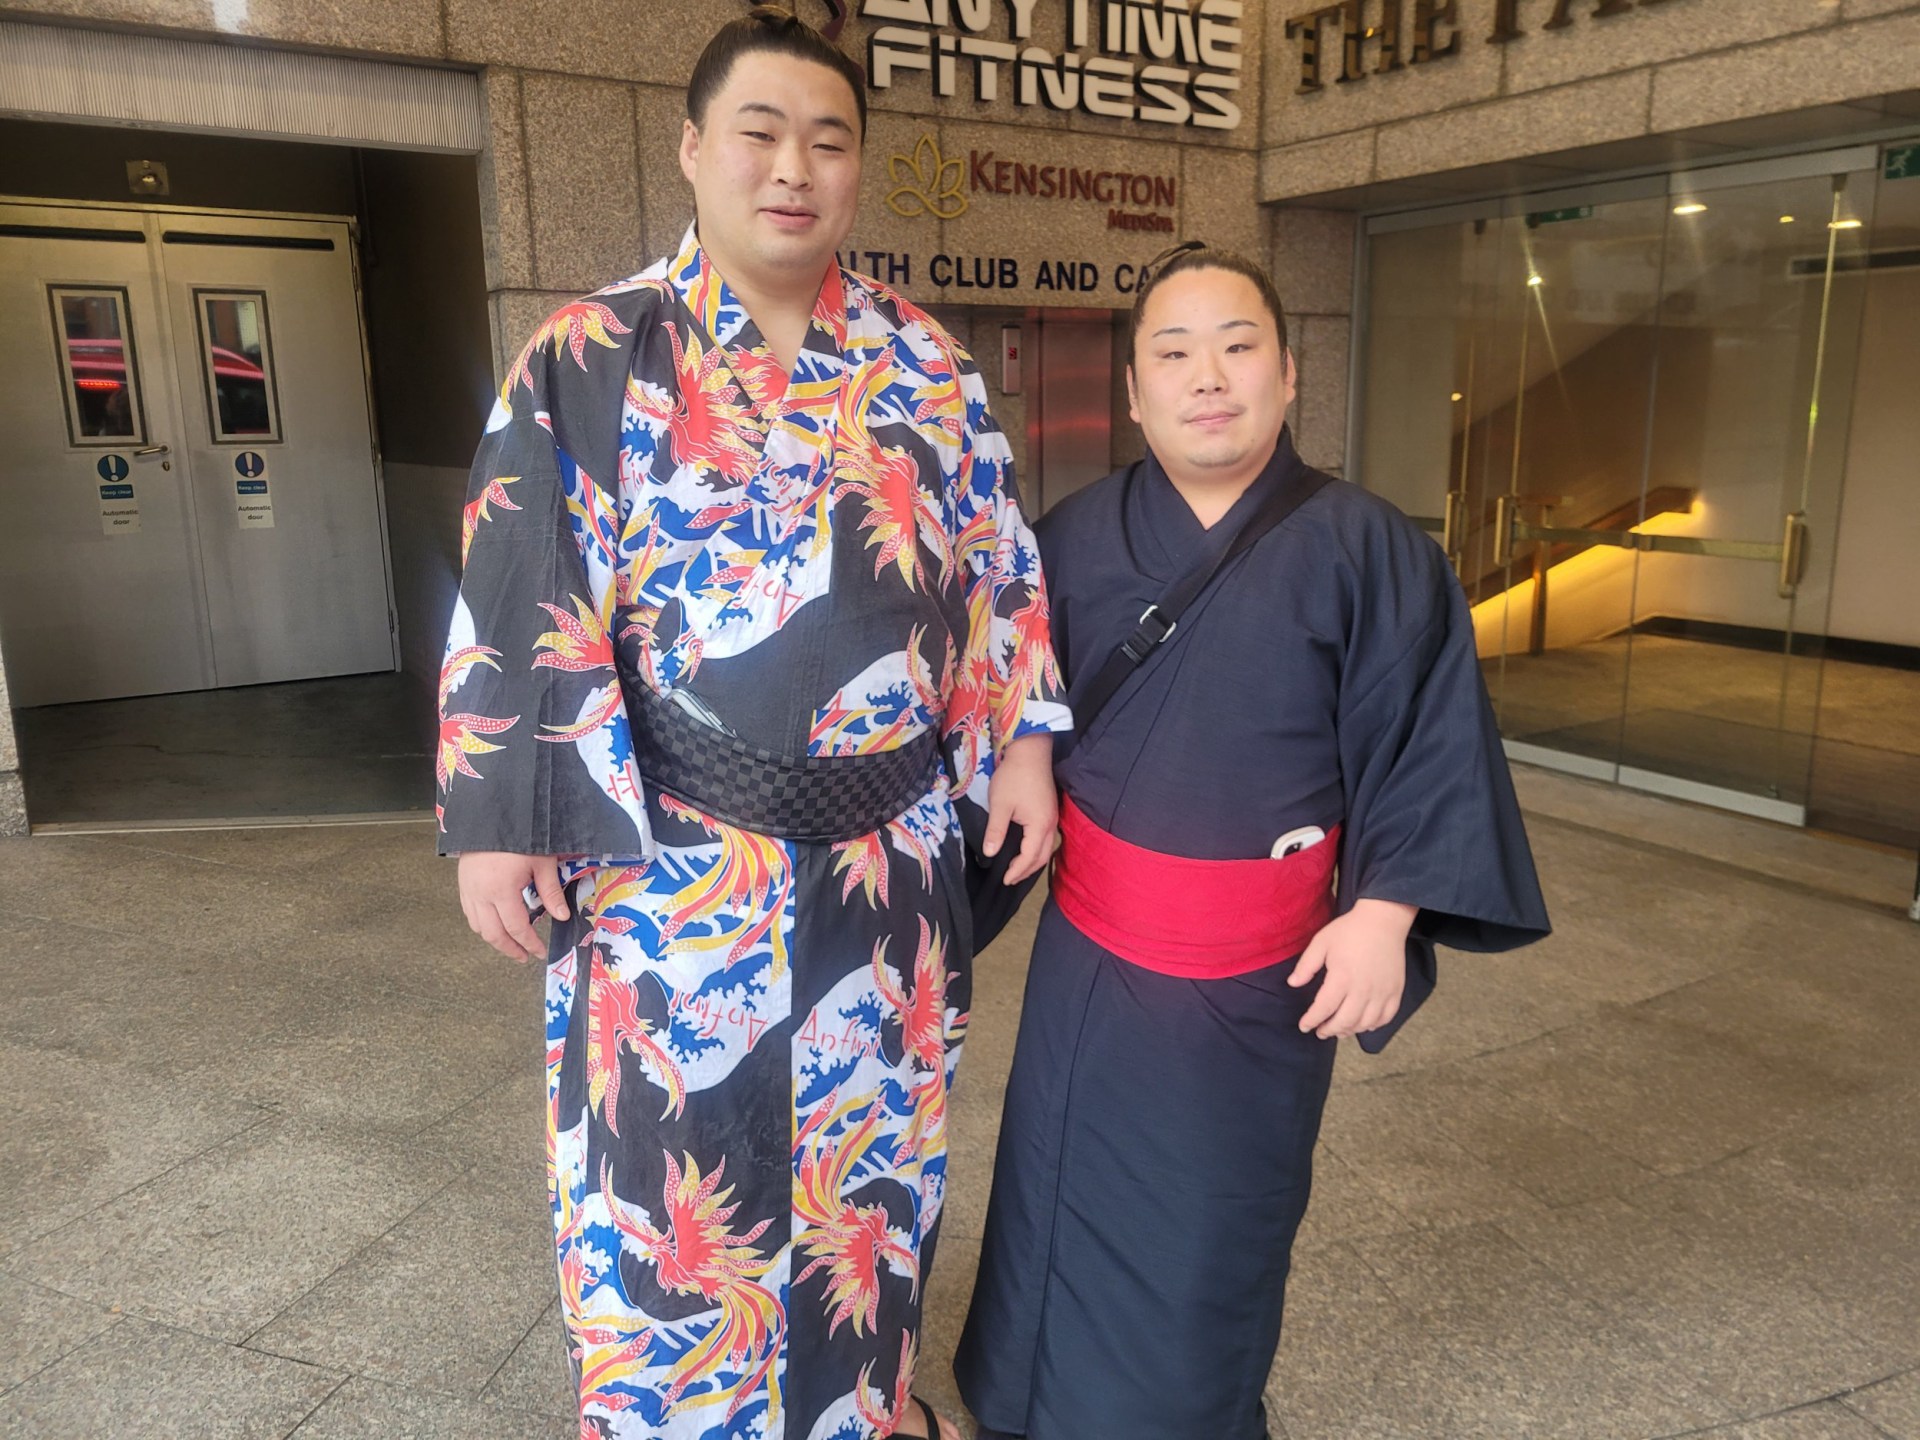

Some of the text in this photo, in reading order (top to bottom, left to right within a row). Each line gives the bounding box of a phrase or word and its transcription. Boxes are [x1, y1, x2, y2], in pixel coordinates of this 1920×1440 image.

[873, 26, 1241, 130] FITNESS
[1285, 0, 1461, 95] THE
[970, 150, 1175, 207] KENSINGTON
[929, 254, 1019, 289] CLUB
[1035, 261, 1099, 292] AND
